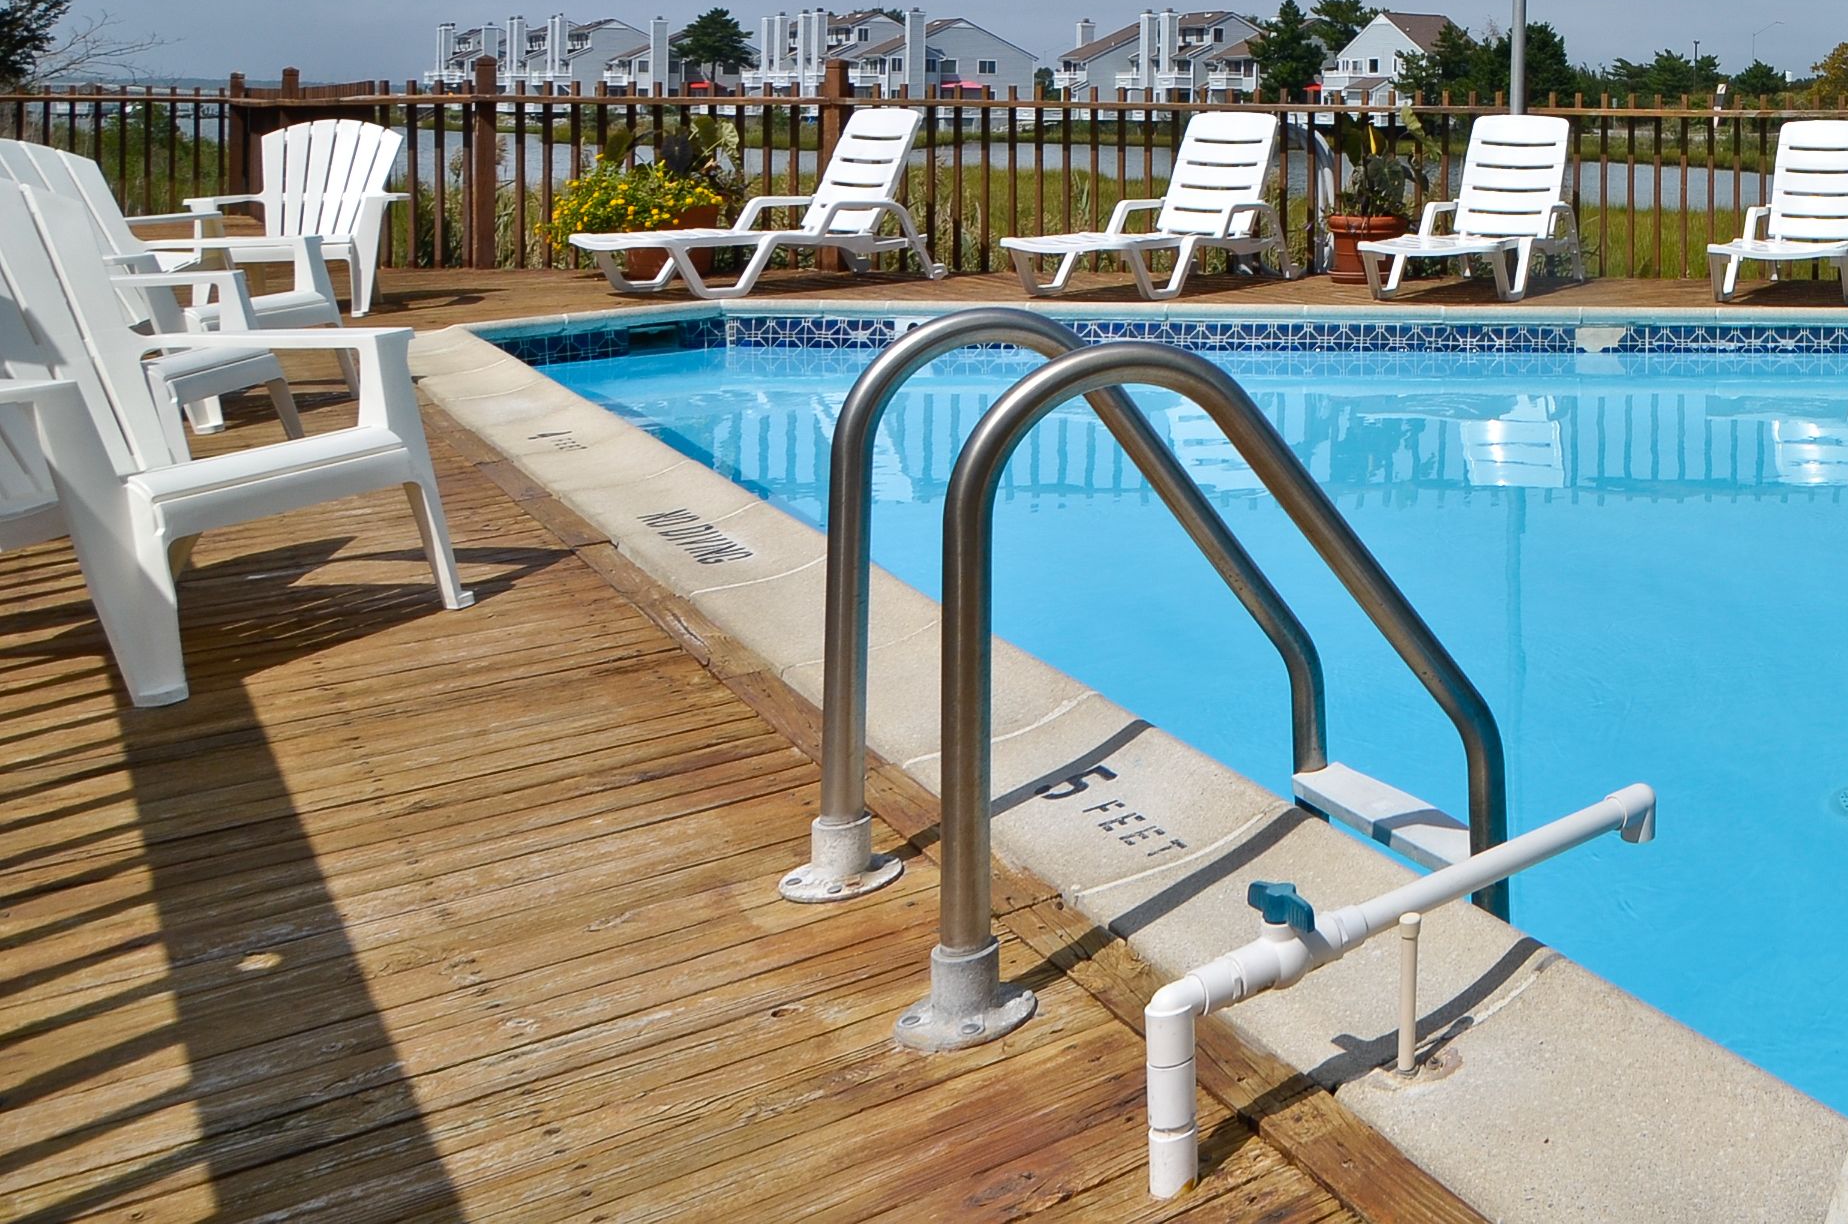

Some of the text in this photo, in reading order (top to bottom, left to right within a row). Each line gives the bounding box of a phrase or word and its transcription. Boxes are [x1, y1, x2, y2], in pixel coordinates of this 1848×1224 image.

[636, 508, 754, 565] NO DIVING
[1034, 764, 1188, 858] 5 FEET
